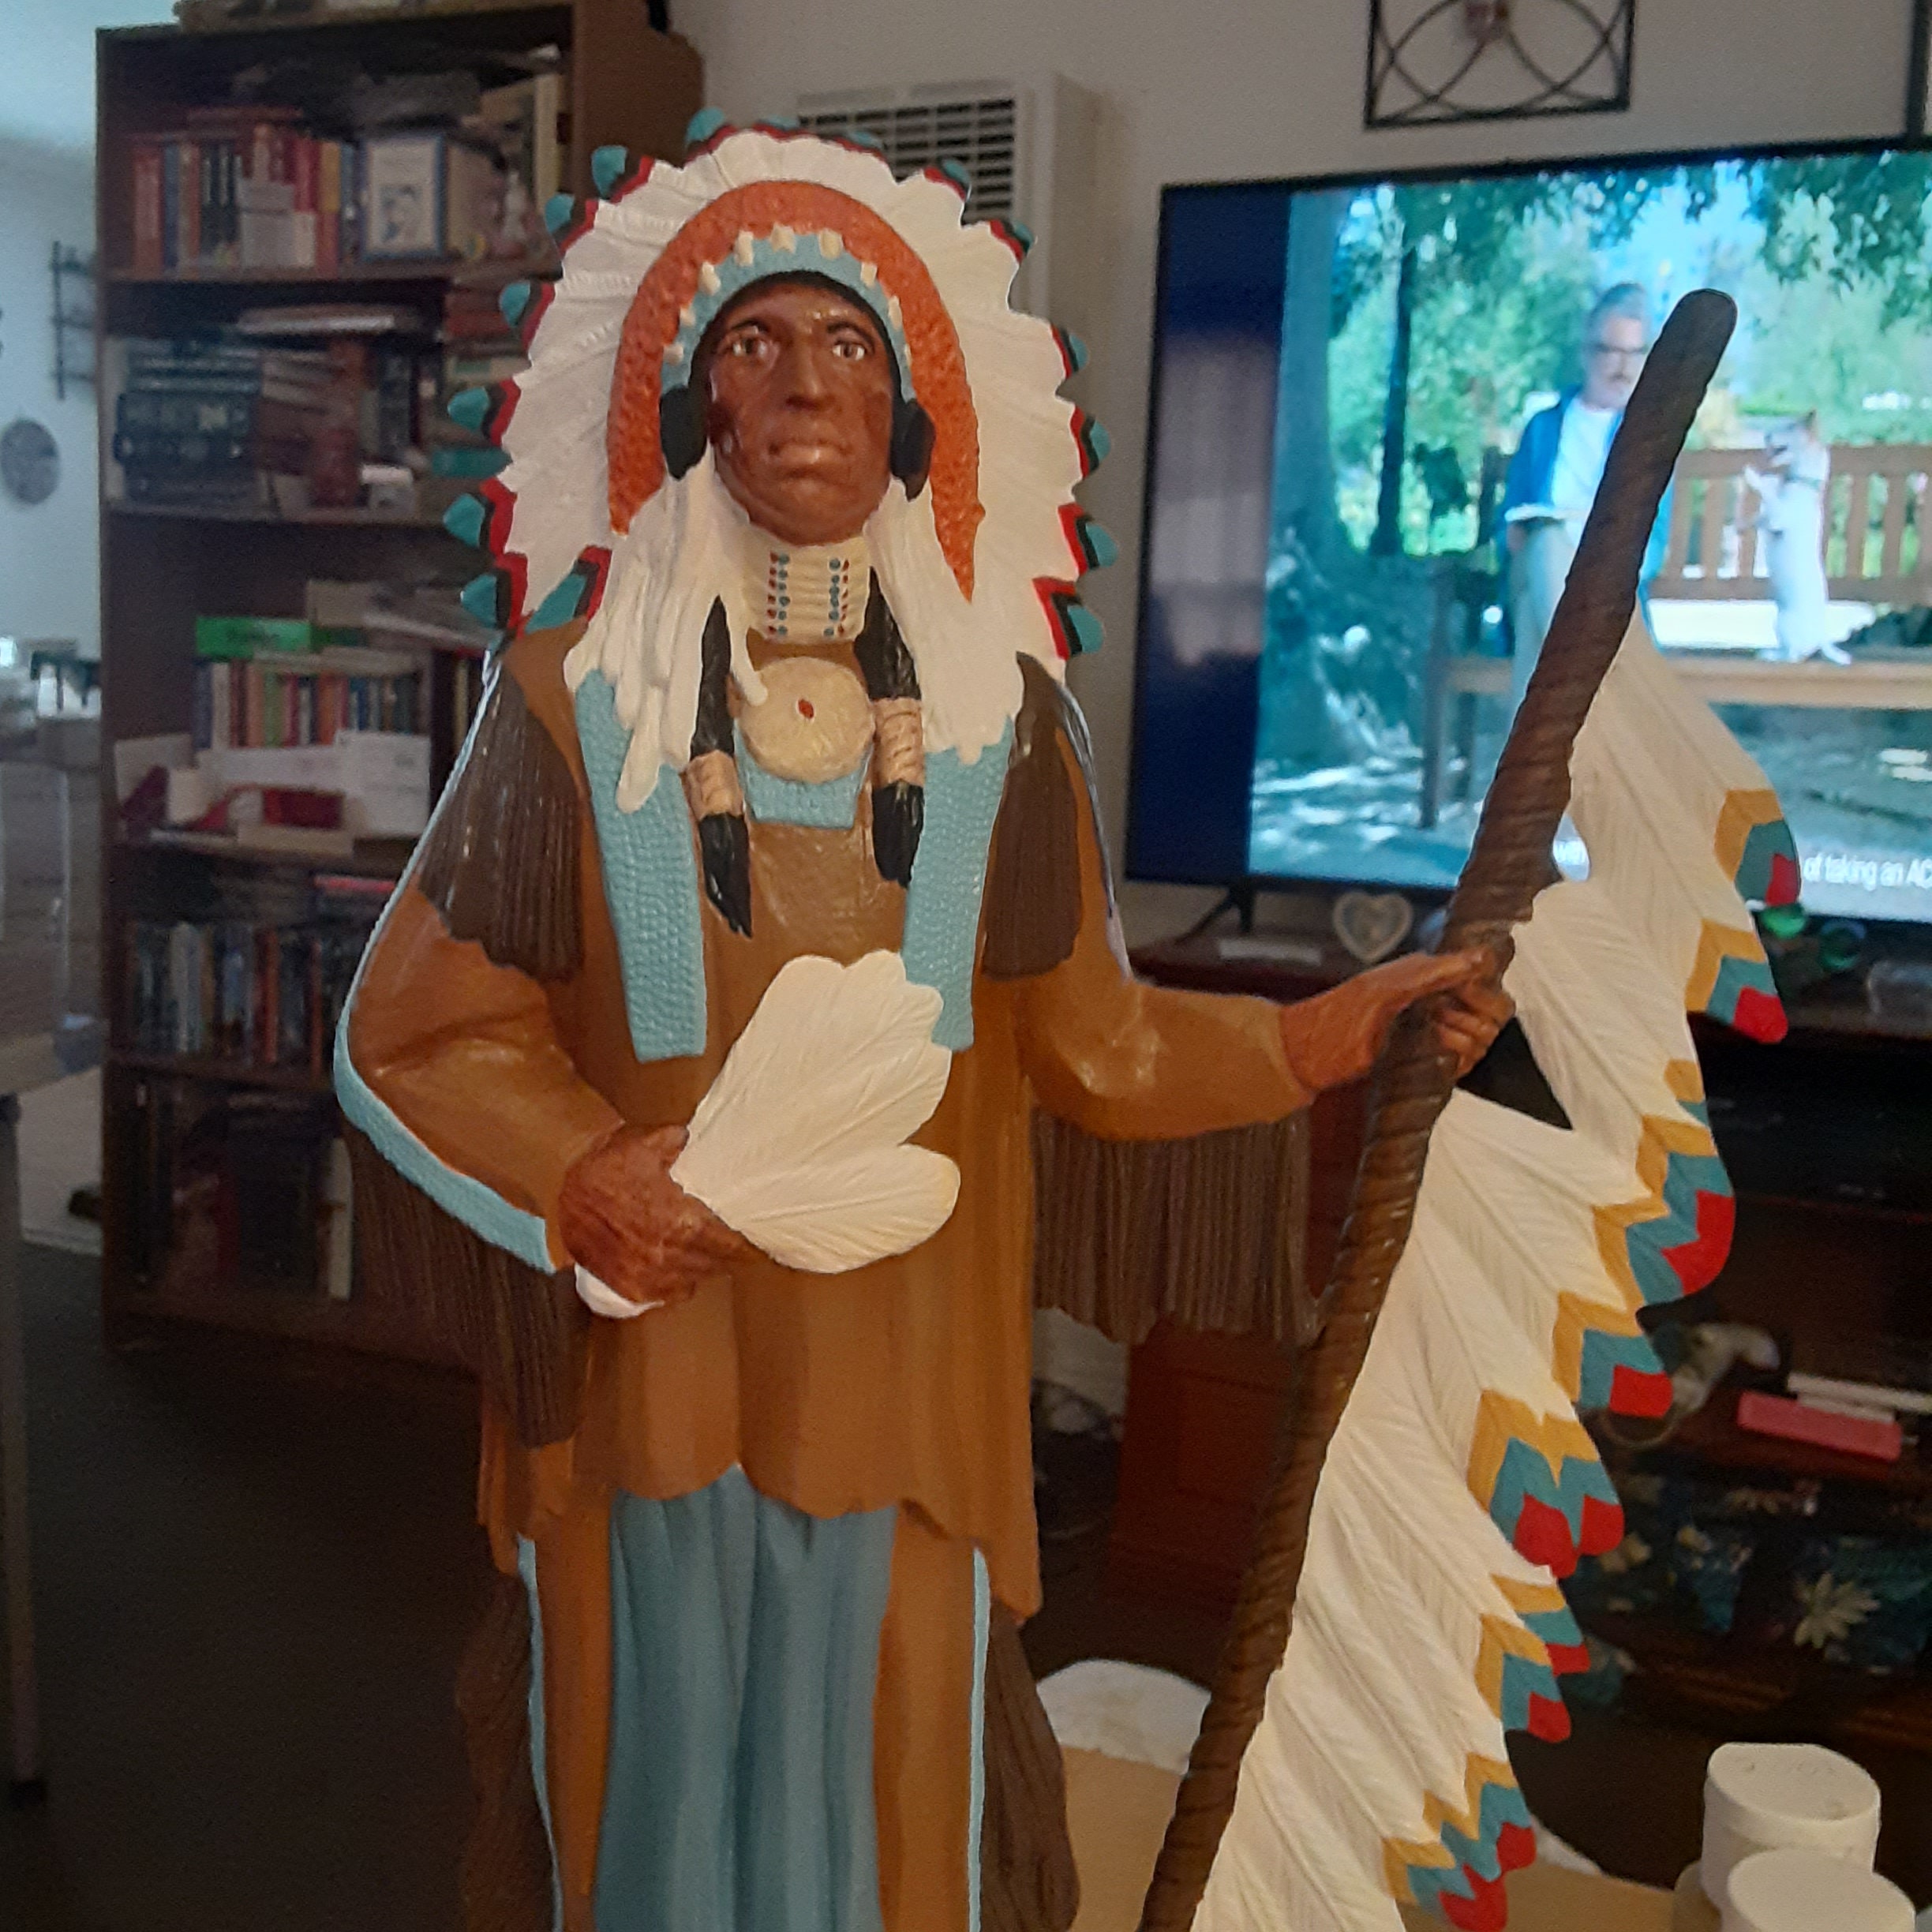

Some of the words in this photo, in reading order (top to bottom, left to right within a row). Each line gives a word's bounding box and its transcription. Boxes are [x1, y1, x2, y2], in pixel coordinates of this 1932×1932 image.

[1803, 852, 1822, 882] of
[1825, 854, 1877, 891] taking
[1880, 861, 1904, 887] an
